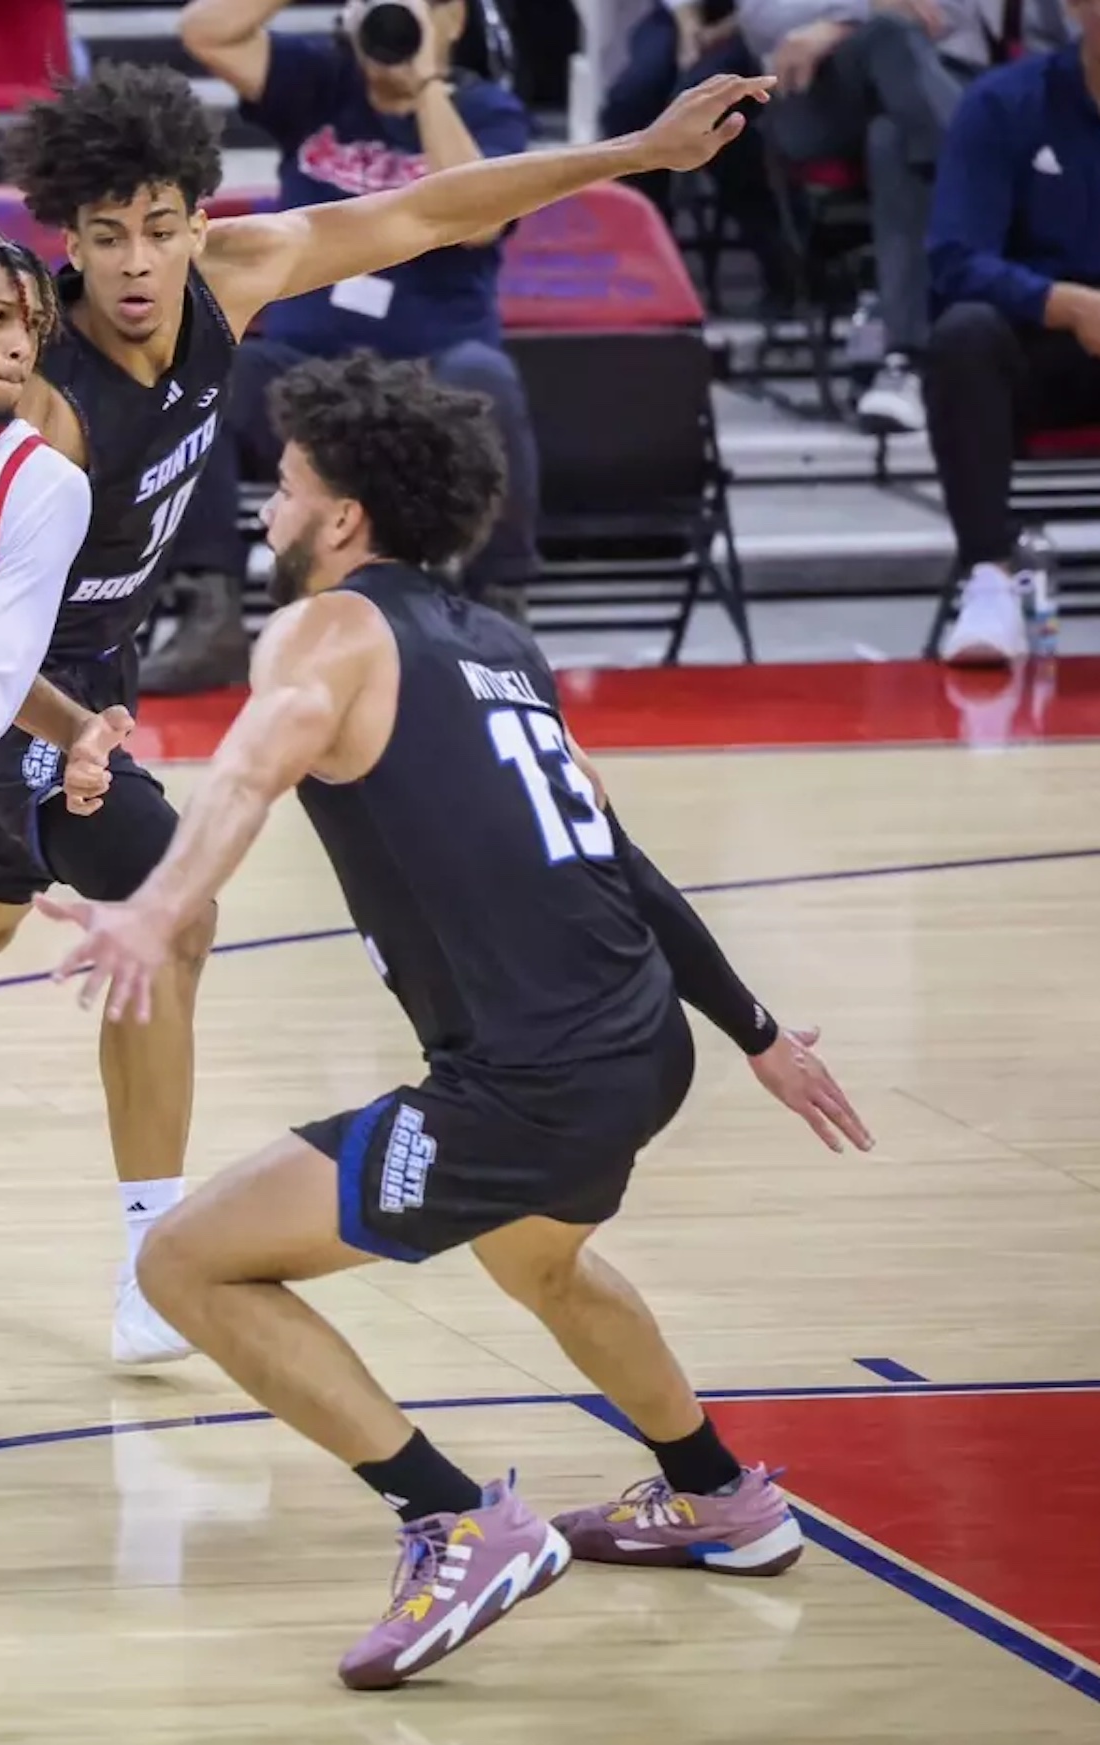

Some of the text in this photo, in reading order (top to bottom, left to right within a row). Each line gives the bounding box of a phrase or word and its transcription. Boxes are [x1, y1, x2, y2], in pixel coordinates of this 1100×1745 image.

[134, 411, 218, 504] SANTA
[139, 474, 198, 562] 10
[487, 706, 616, 866] 13
